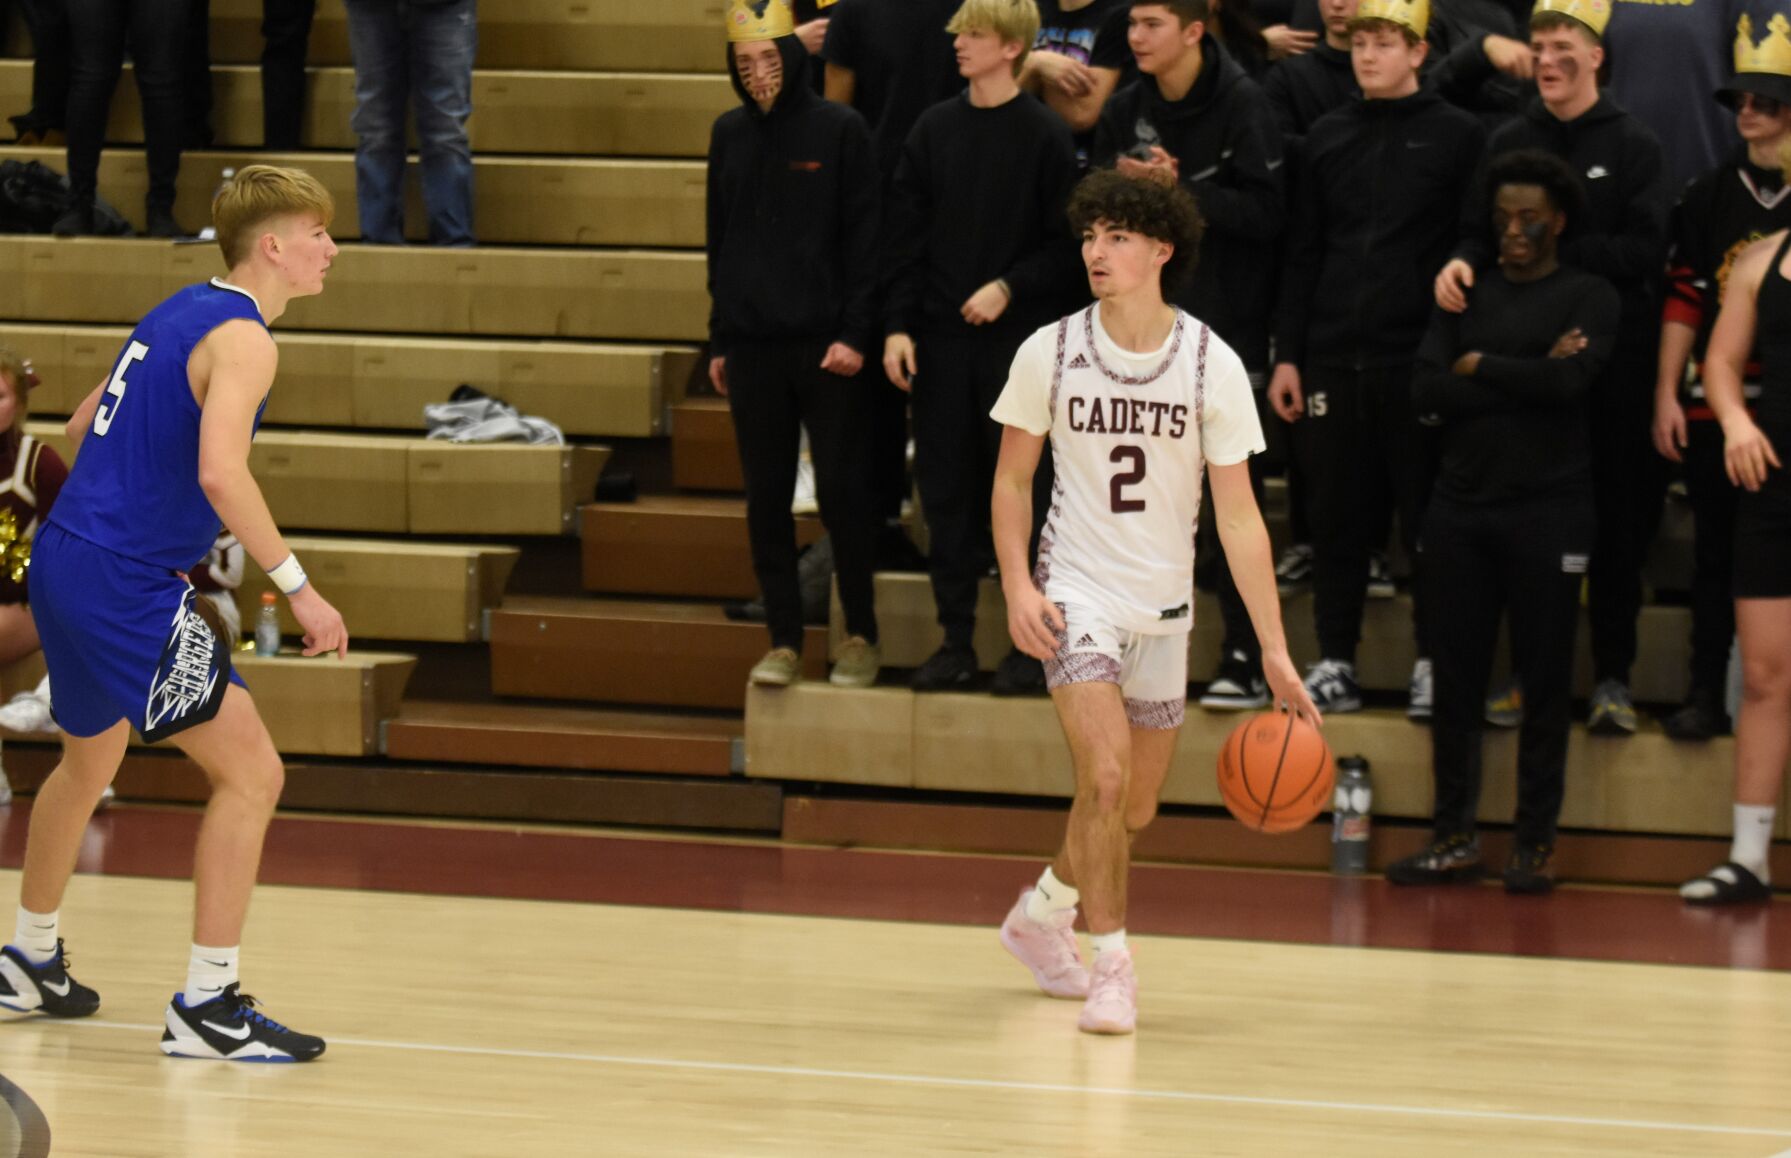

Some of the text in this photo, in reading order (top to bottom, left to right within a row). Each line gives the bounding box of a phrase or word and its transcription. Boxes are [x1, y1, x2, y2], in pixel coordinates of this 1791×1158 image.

[93, 339, 150, 437] 5
[1068, 397, 1188, 439] CADETS
[1109, 445, 1146, 513] 2
